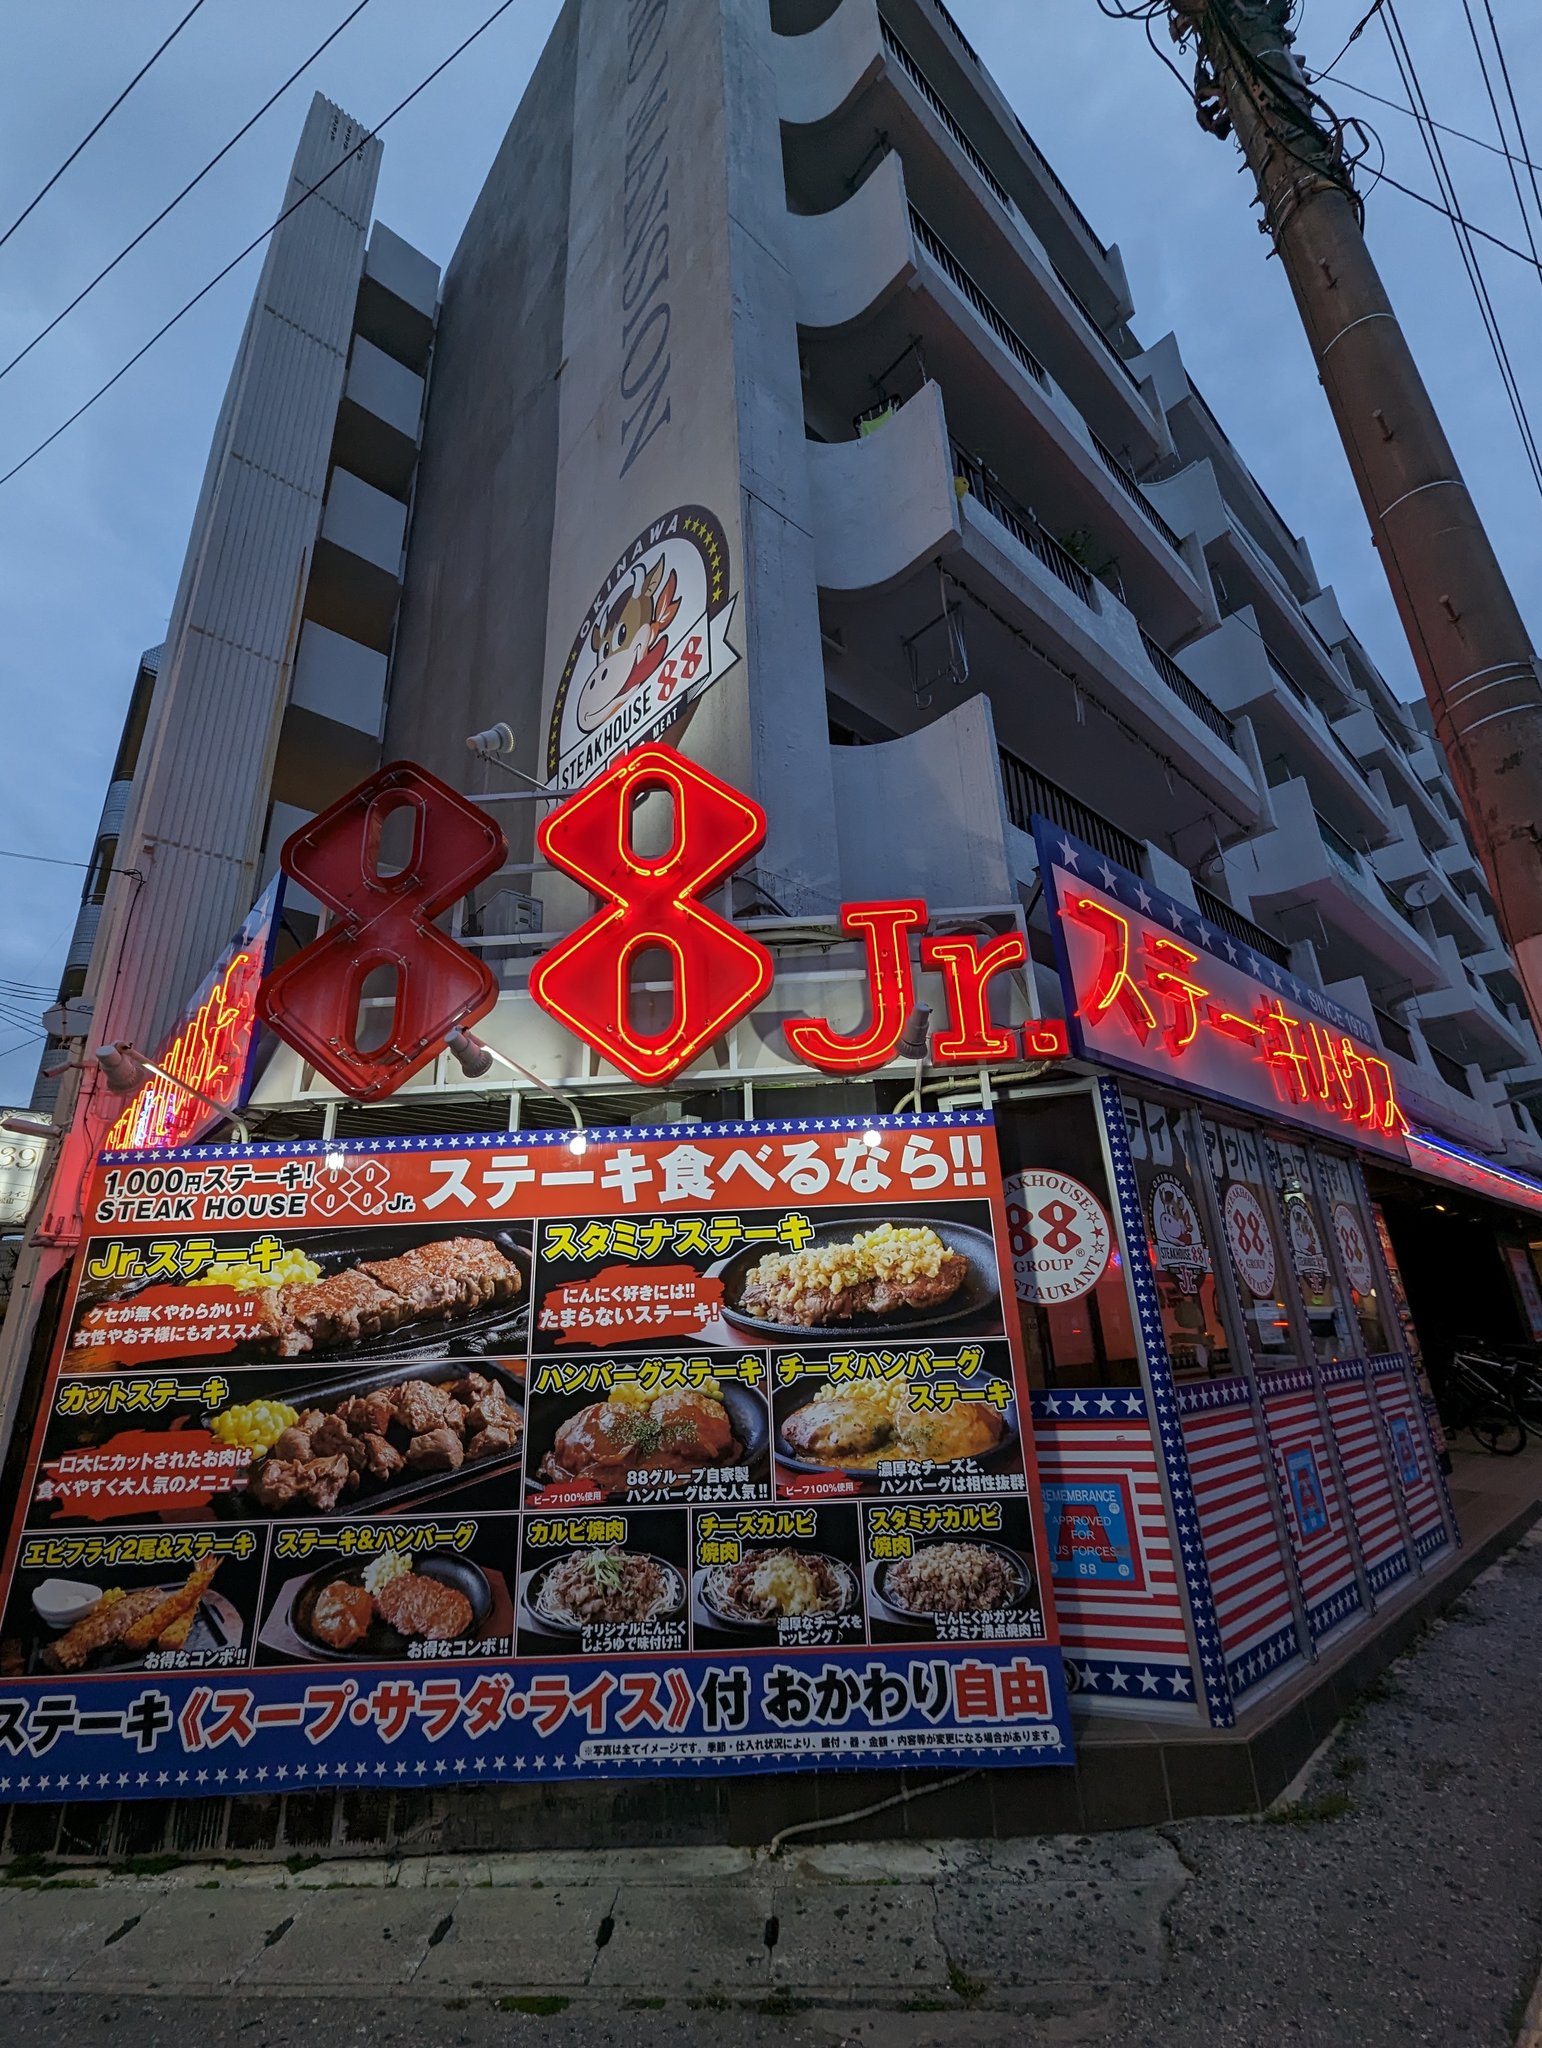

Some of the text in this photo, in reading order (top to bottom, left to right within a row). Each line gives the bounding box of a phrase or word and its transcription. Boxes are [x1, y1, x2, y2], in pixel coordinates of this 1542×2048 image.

[619, 50, 671, 480] MANSION
[579, 514, 678, 639] OKINAWA
[561, 635, 703, 790] STEAKHOUSE 88
[652, 707, 678, 739] MEAT
[256, 742, 774, 1103] 88
[782, 898, 1069, 1074] Jr.
[1057, 890, 1411, 1137] ステーキハウス
[1307, 989, 1371, 1043] SINCE 1978
[96, 1158, 416, 1222] STEAK HOUSE 88 Jr.
[104, 1162, 313, 1196] 1,000円ステーキ!
[542, 1212, 814, 1262] スタミナステーキ
[1006, 1200, 1082, 1257] 88
[1233, 1208, 1265, 1256] 88
[89, 1235, 285, 1279] Jr.ステーキ
[1014, 1259, 1073, 1274] GROUP
[1160, 1247, 1192, 1260] STEAKHOUSE
[540, 1301, 720, 1331] たまらないステーキ!
[74, 1322, 261, 1348] 女性やお子様にもオススメ
[535, 1355, 766, 1395] ハンバーグステーキ
[777, 1347, 983, 1384] チーズハンバーグ
[56, 1376, 230, 1415] カットステーキ
[909, 1379, 1015, 1414] ステーキ
[42, 1449, 252, 1475] 一口大にカットされたお肉は
[36, 1473, 249, 1502] 食べやすく大人気のメニュー
[626, 1467, 750, 1488] 88グループ自家製
[785, 1481, 855, 1497] ビーフ100%使用
[879, 1473, 1024, 1494] ハンバーグは相性抜群
[533, 1491, 603, 1506] ビーフ100%使用
[528, 1517, 627, 1546] カルビ焼肉
[698, 1508, 817, 1539] チーズカルビ
[870, 1503, 1001, 1533] スタミナカルビ
[1052, 1515, 1112, 1527] APPROVED
[23, 1530, 256, 1568] エビフライ2尾&ステーキ
[276, 1519, 477, 1556] ステーキ&ハンバーグ
[871, 1533, 914, 1561] 焼肉
[1071, 1530, 1096, 1540] FOR
[697, 1537, 741, 1566] 焼肉
[1054, 1545, 1117, 1557] US FORCES
[1079, 1563, 1097, 1575] 88
[581, 1620, 687, 1638] オリジナルにんにく
[776, 1613, 863, 1632] 濃厚なチーズを
[933, 1610, 1041, 1626] にんにくがガツンと
[764, 1657, 1053, 1727] おかわり自由
